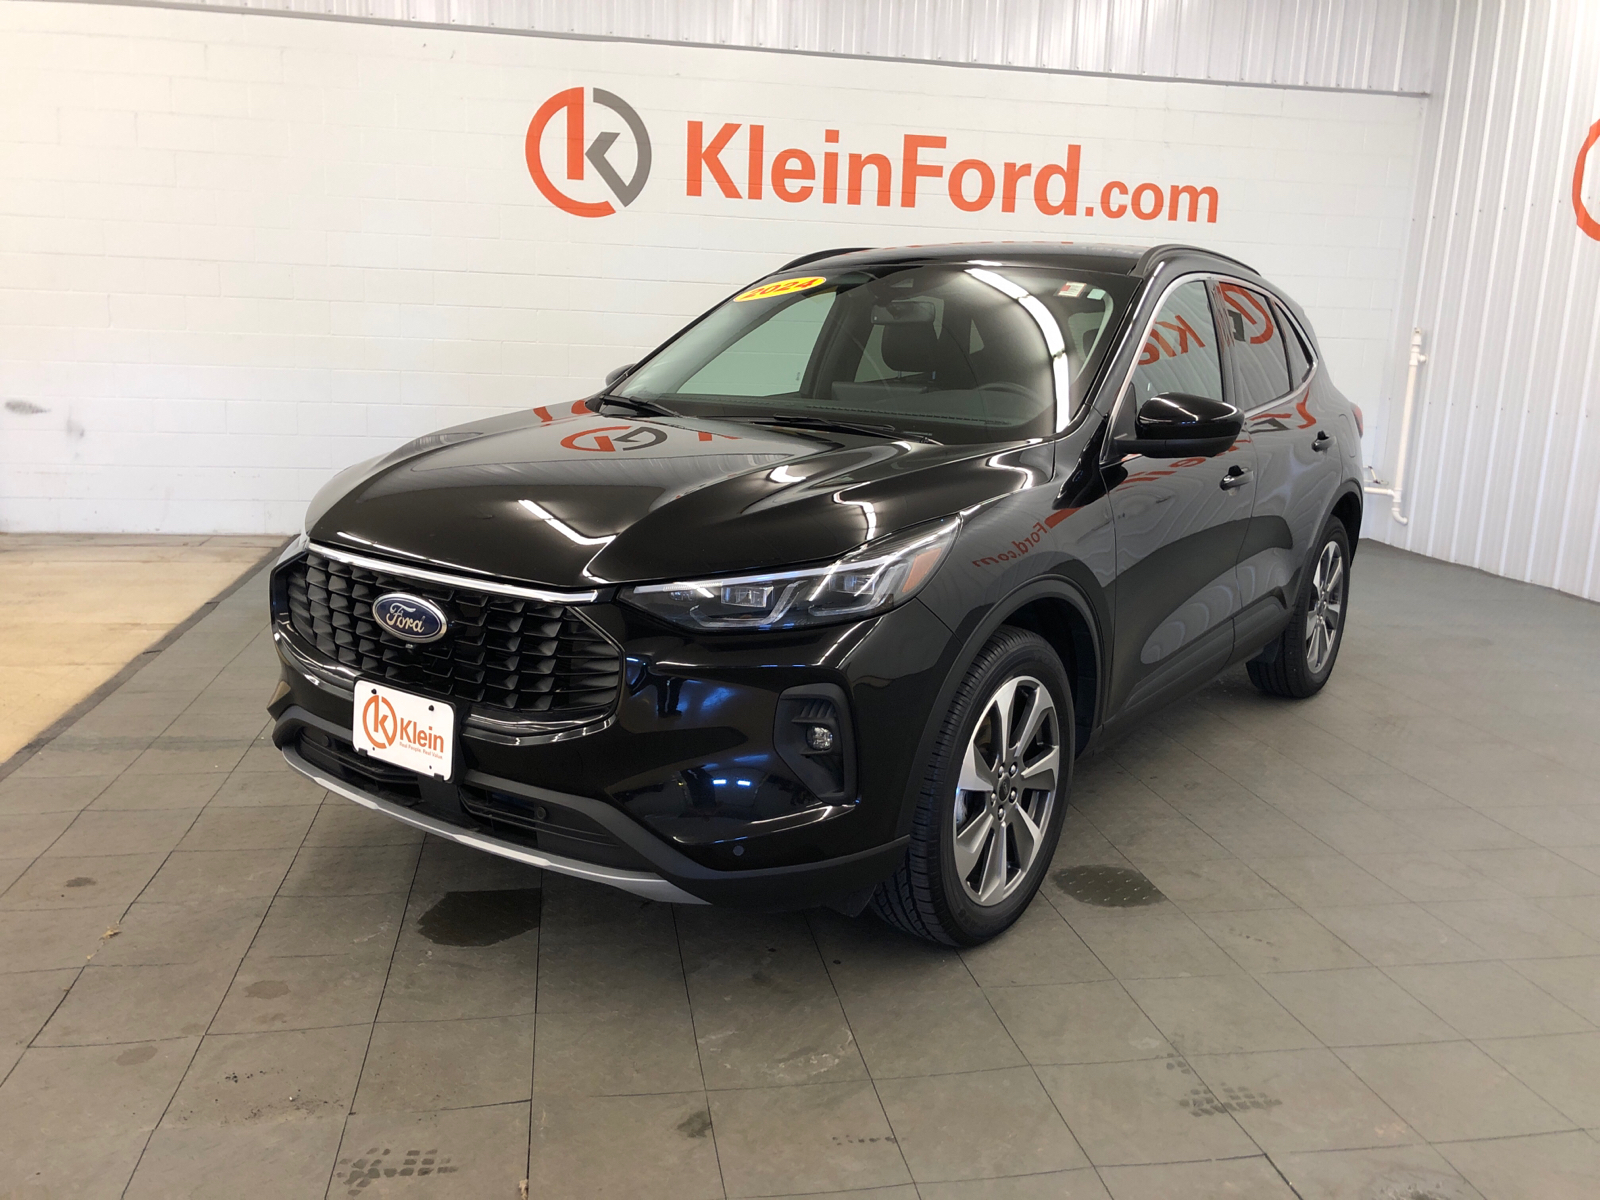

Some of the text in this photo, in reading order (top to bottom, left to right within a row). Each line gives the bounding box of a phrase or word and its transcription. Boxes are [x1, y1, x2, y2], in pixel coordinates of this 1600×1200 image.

[686, 120, 1219, 223] KleinFord.com
[741, 277, 820, 300] 2024
[385, 602, 426, 633] Ford
[399, 717, 445, 754] Klein
